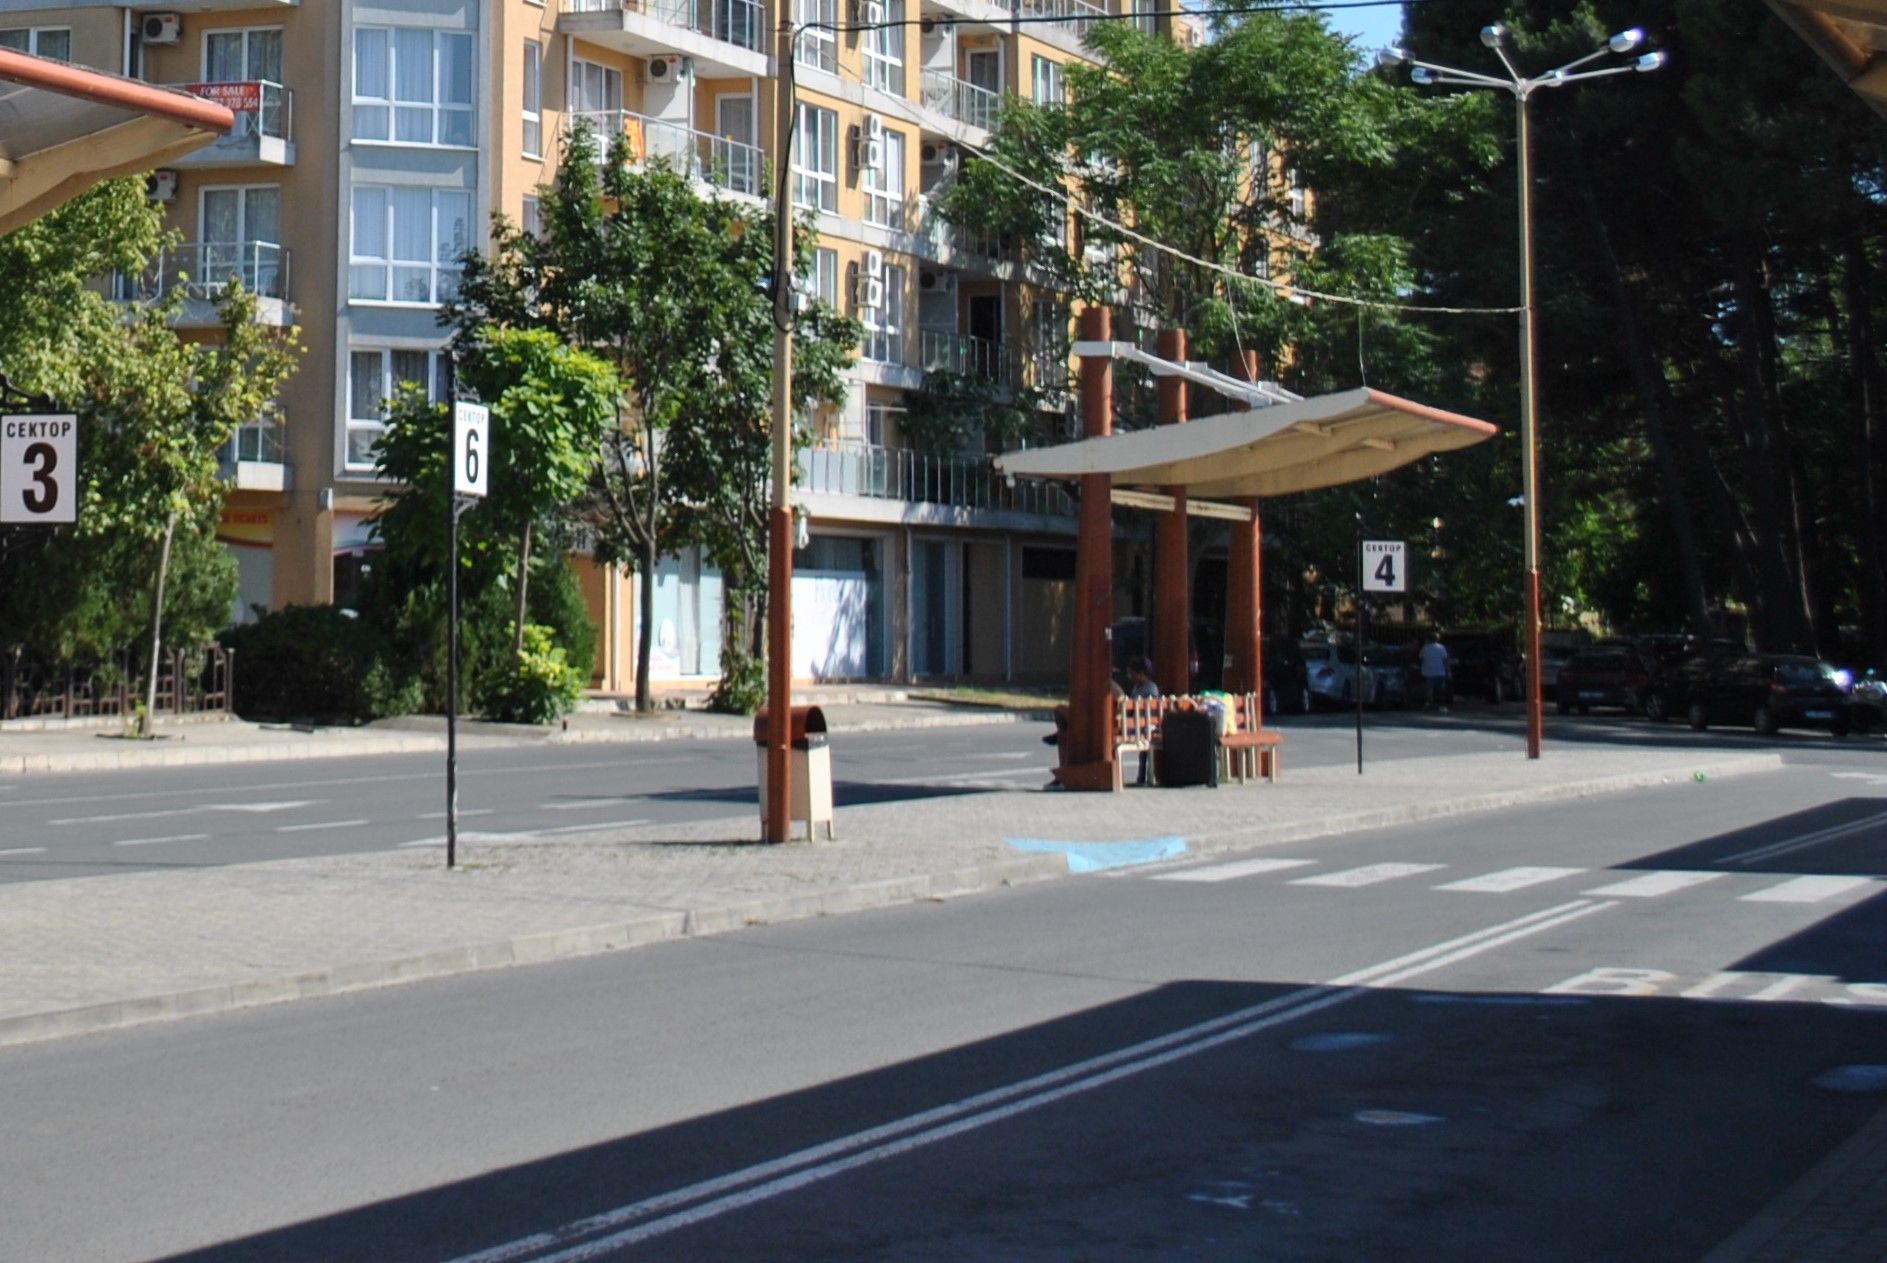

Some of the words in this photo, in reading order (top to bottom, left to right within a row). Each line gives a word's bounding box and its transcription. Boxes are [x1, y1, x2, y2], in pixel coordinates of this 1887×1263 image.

[200, 86, 220, 97] FOR
[222, 85, 245, 96] SALE
[6, 422, 71, 438] СЕКТОР
[466, 428, 479, 484] 6
[22, 442, 58, 514] 3
[1374, 554, 1396, 587] 4
